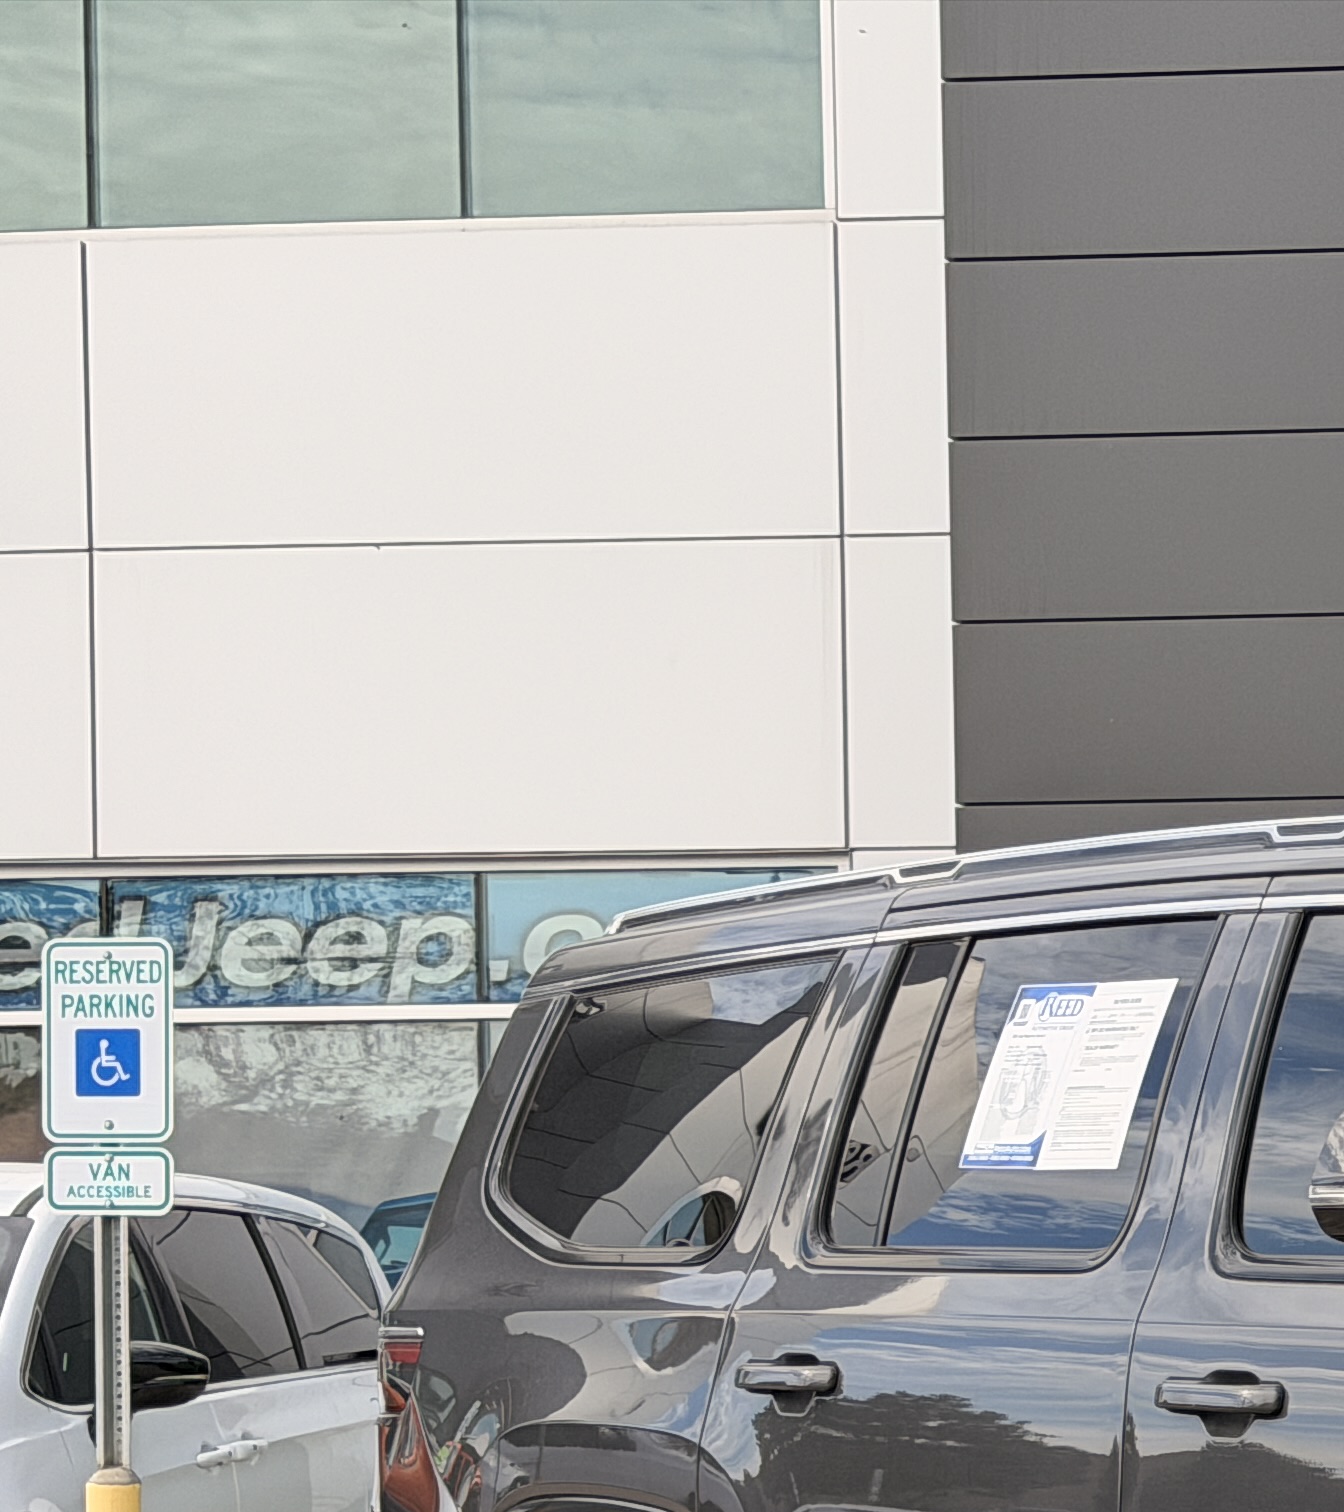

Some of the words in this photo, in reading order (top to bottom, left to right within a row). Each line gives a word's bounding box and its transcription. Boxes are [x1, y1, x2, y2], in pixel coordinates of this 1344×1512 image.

[54, 960, 162, 984] RESERVED
[61, 993, 155, 1018] PARKING
[88, 1163, 131, 1181] VAN
[66, 1185, 152, 1198] ACCESSIBLE
